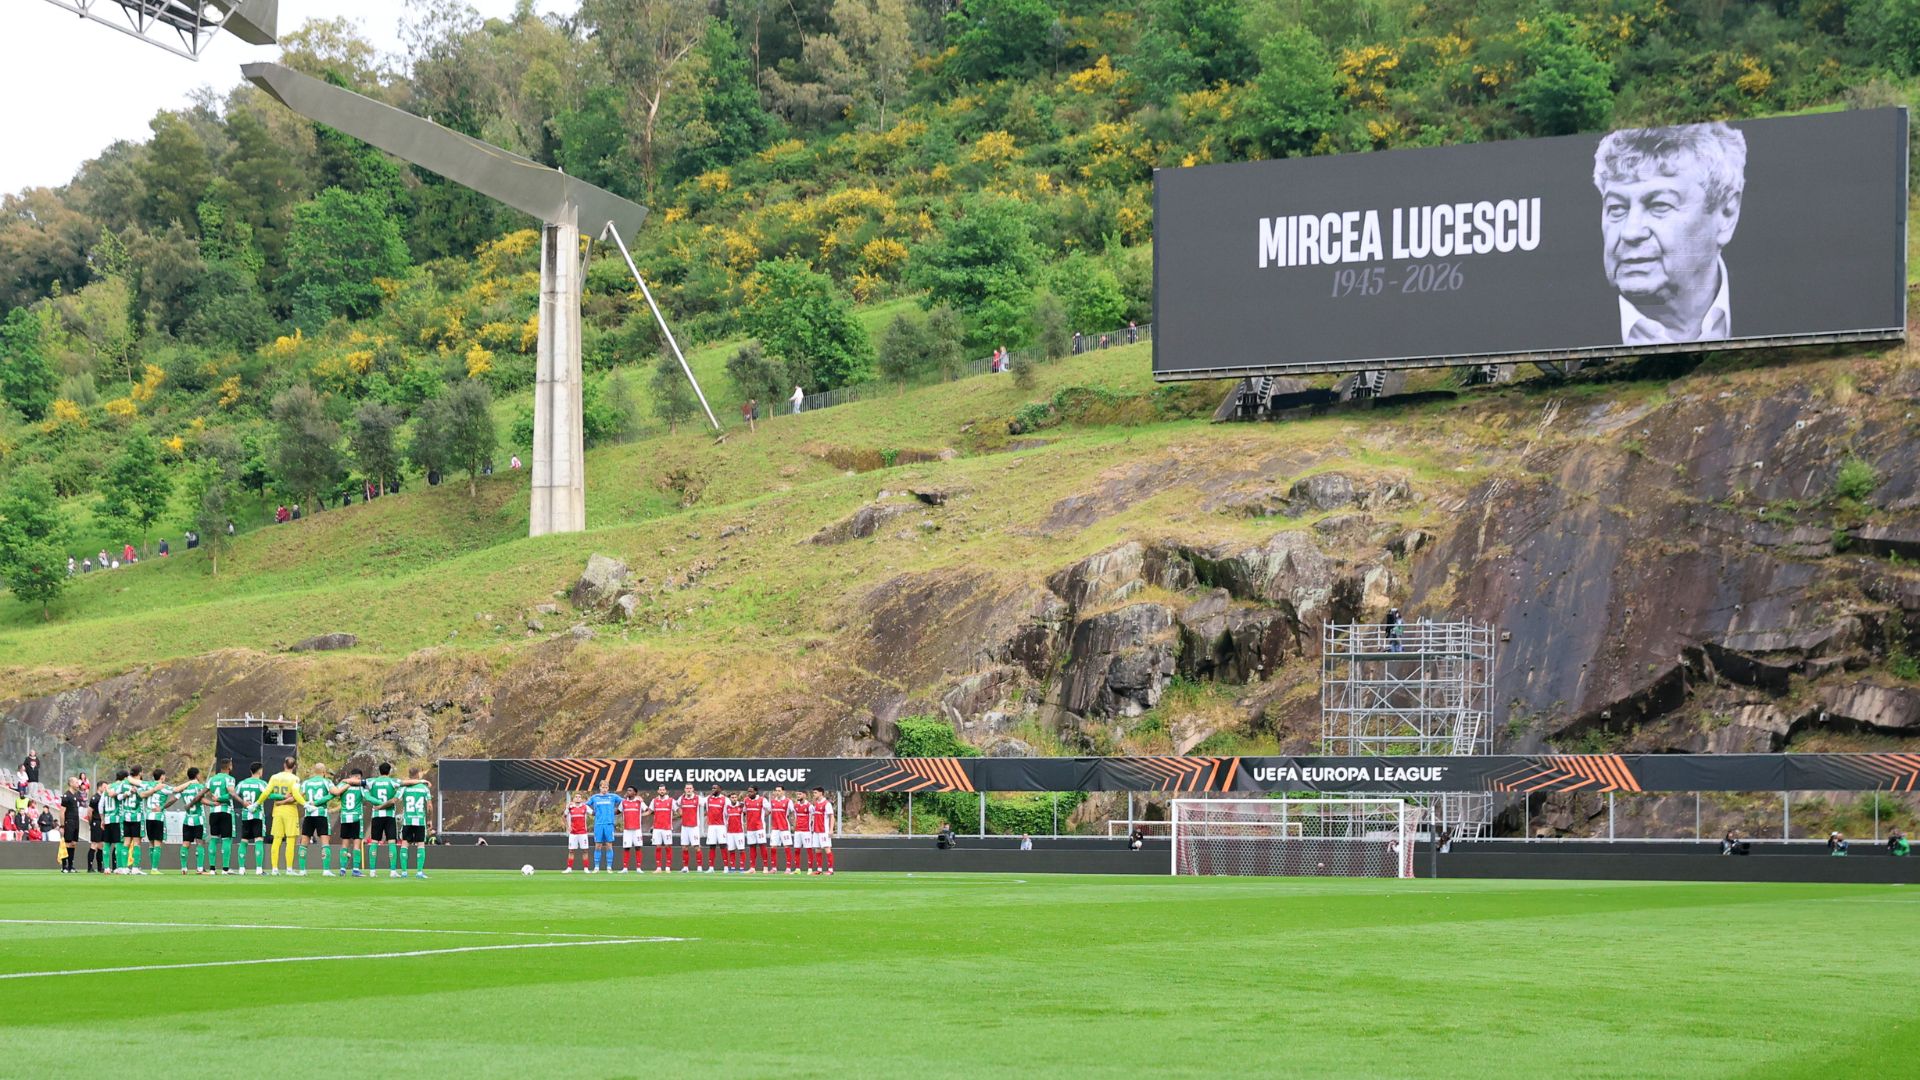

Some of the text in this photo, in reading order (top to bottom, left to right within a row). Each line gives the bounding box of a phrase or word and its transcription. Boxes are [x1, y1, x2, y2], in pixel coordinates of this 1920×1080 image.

[1259, 197, 1541, 268] MIRCEA LUCESCU
[1331, 266, 1386, 298] 1945
[1401, 261, 1464, 294] 2026
[644, 768, 684, 783] UEFA
[686, 768, 745, 783] EUROPA
[1253, 766, 1299, 782] UEFA
[1302, 766, 1371, 782] EUROPA
[242, 790, 256, 804] 21
[307, 788, 323, 804] 14
[345, 792, 356, 810] 8
[377, 788, 388, 803] 5
[405, 795, 425, 813] 24
